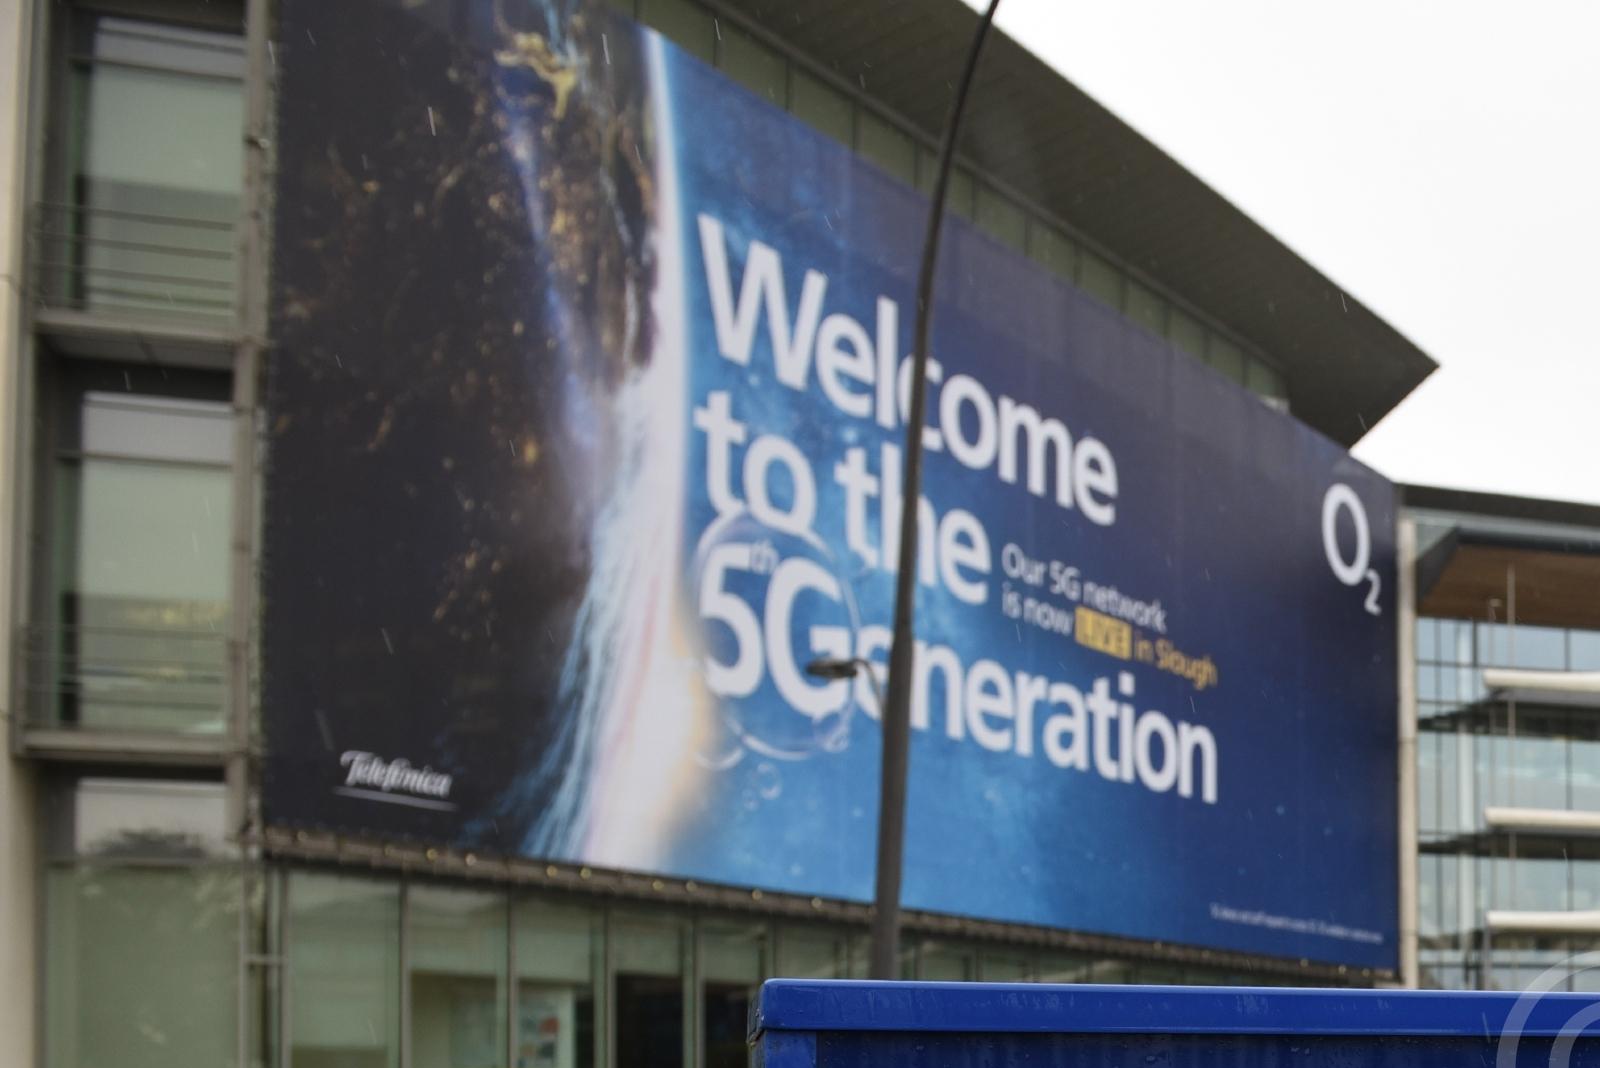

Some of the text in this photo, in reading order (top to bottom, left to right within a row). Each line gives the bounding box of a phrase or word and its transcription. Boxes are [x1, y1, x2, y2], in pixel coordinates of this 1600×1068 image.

[698, 213, 1118, 527] Welcome
[694, 391, 991, 604] to the
[1001, 542, 1167, 635] Our 5G network
[1002, 580, 1023, 620] is
[1023, 596, 1074, 637] now
